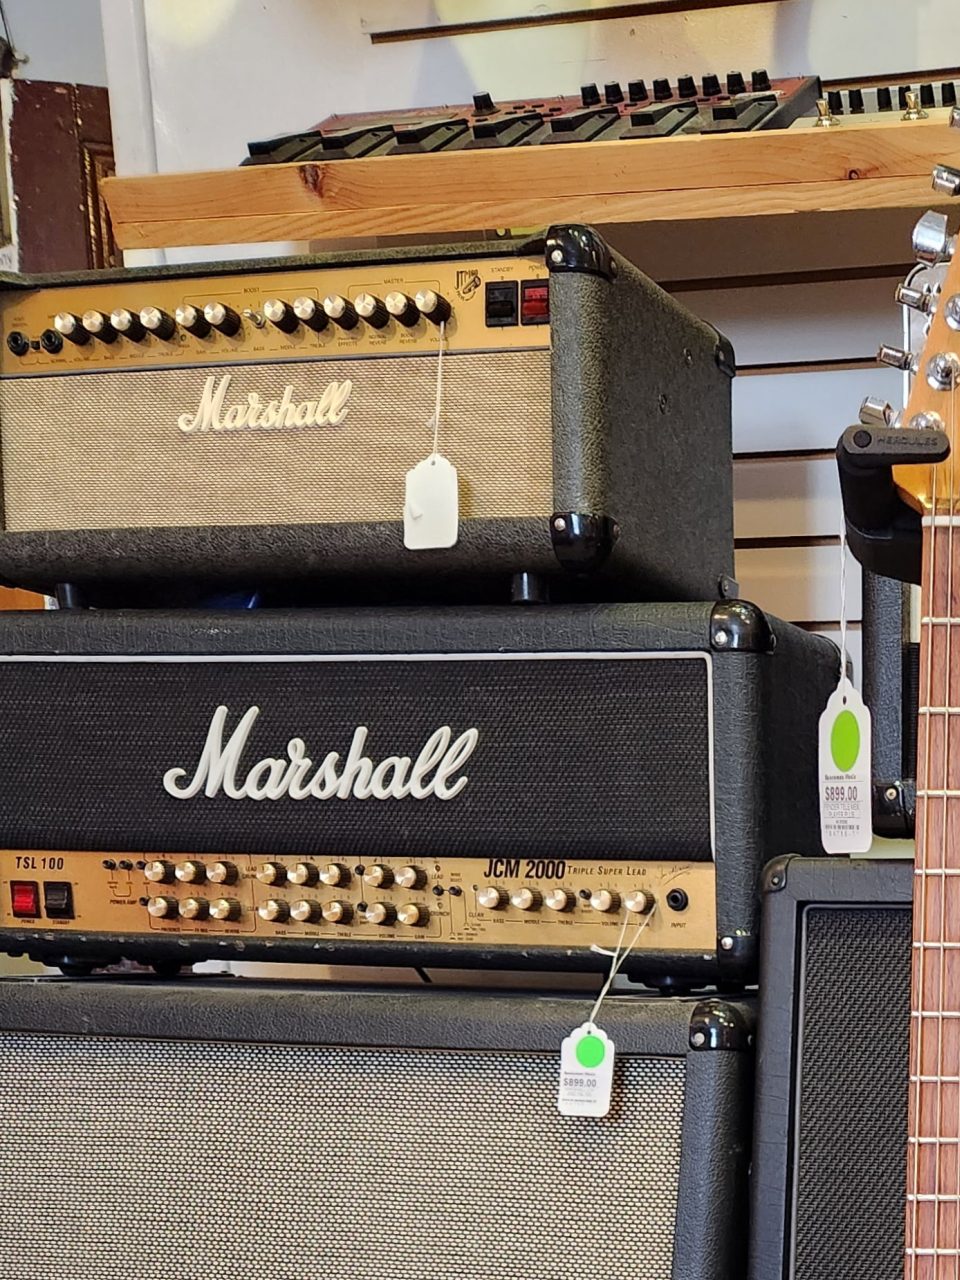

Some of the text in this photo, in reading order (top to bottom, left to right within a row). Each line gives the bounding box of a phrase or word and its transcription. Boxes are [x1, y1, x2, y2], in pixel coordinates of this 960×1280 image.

[177, 374, 353, 433] Marshall
[877, 436, 938, 447] HERCULES
[163, 705, 479, 800] Marshall
[825, 786, 858, 801] $899.00
[16, 856, 64, 870] TSL 100
[484, 860, 566, 879] JCM 2000
[567, 865, 594, 875] TRIPLE
[597, 865, 623, 876] SUPER
[626, 866, 647, 876] LEAD
[563, 1078, 597, 1087] $899.00
